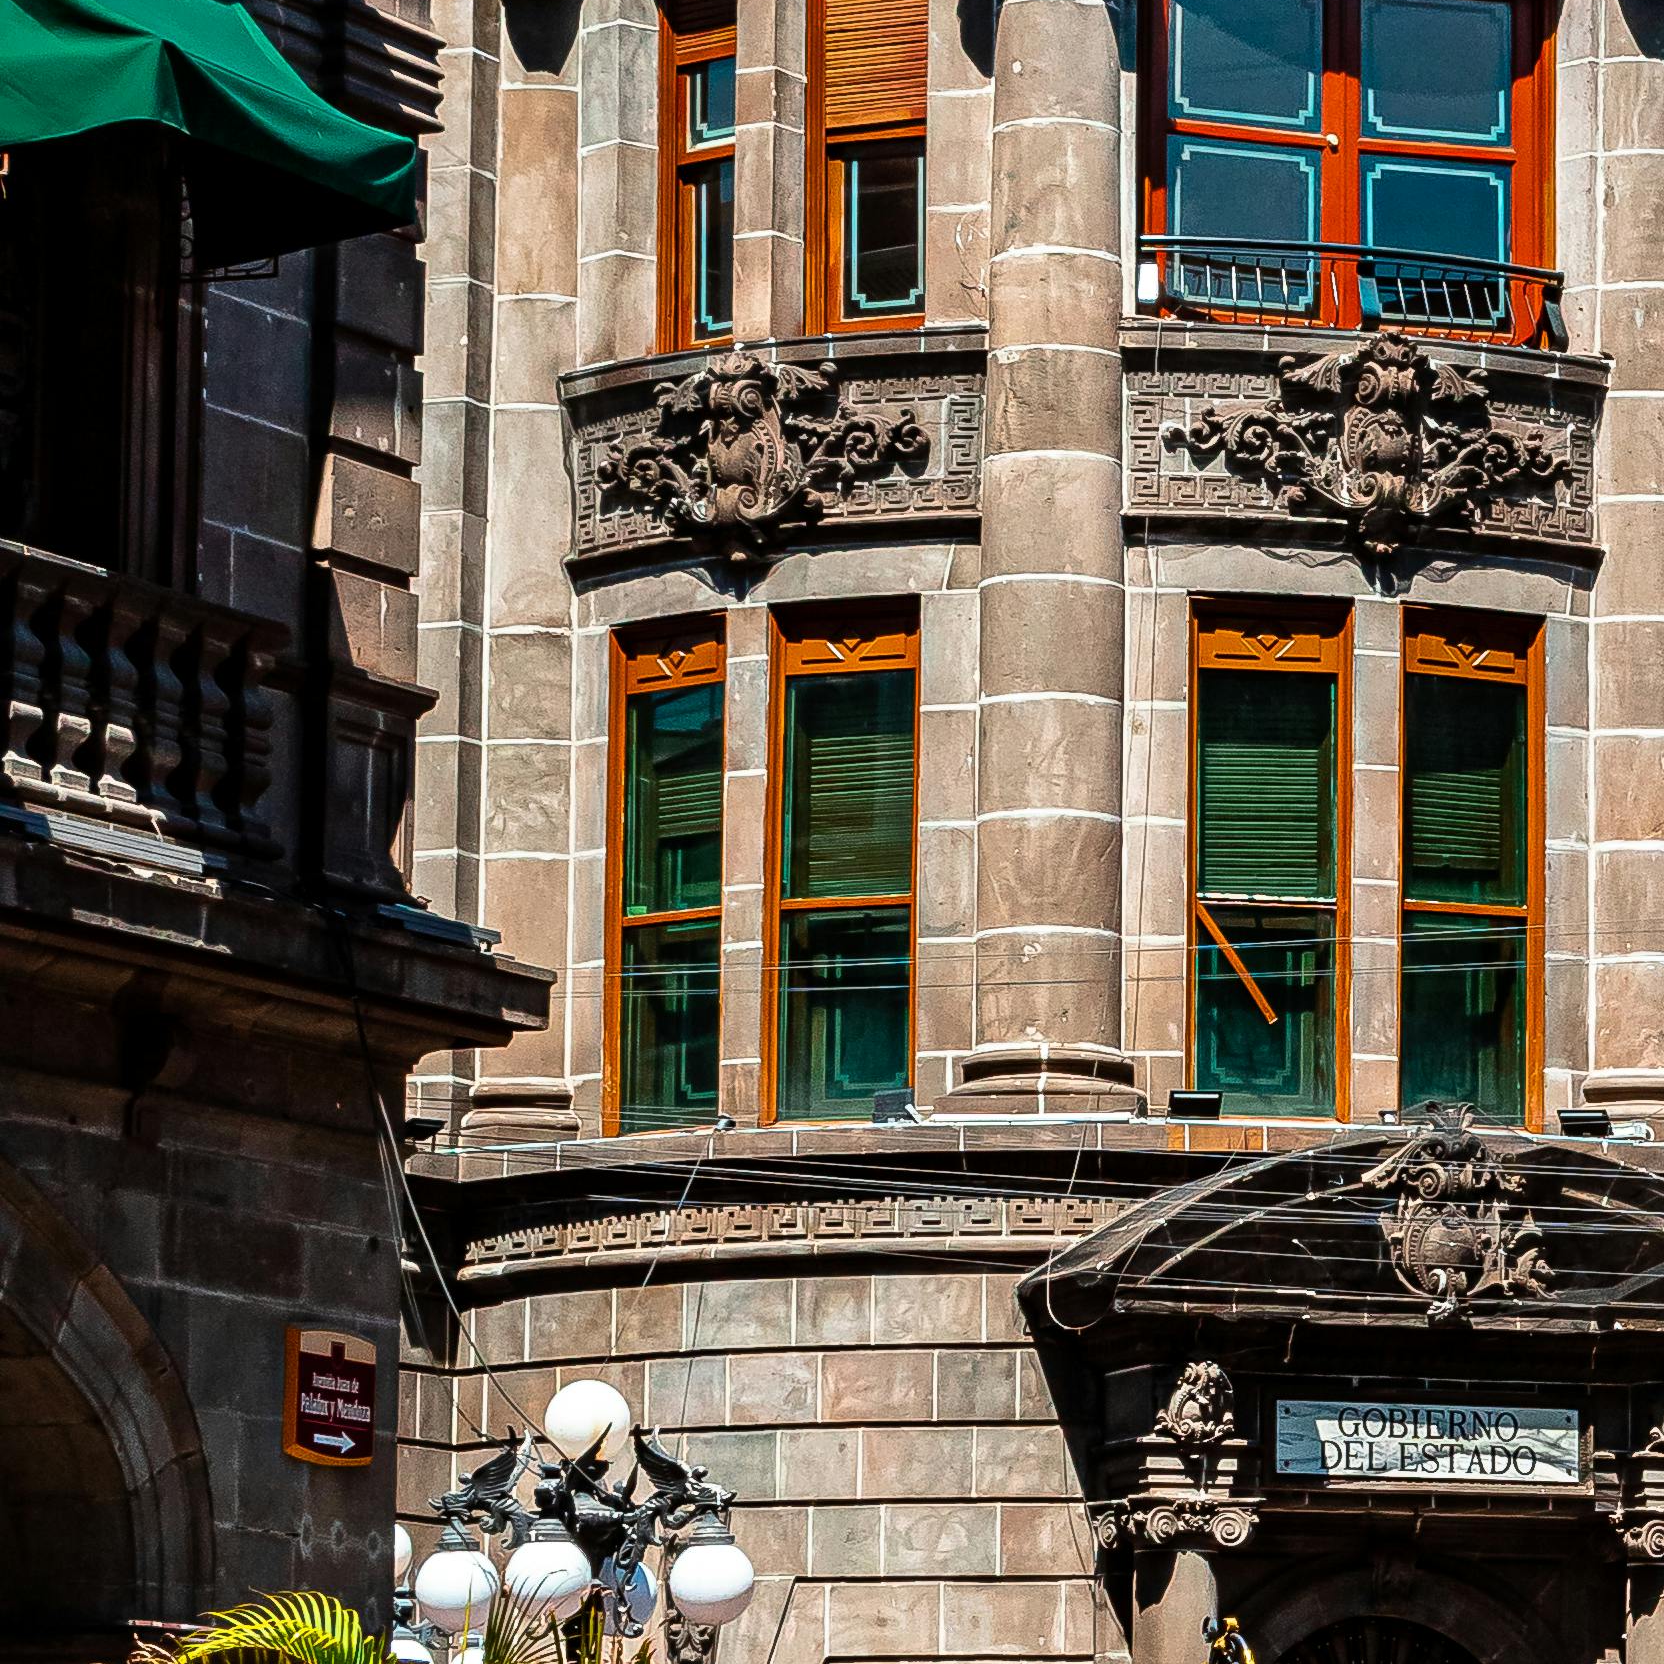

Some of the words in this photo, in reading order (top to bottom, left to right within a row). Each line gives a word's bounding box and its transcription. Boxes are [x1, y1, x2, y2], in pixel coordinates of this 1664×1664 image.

[329, 1401, 336, 1423] y
[1338, 1407, 1519, 1443] GOBIERNO
[1320, 1440, 1388, 1473] DEL
[1399, 1442, 1538, 1476] ESTADO
